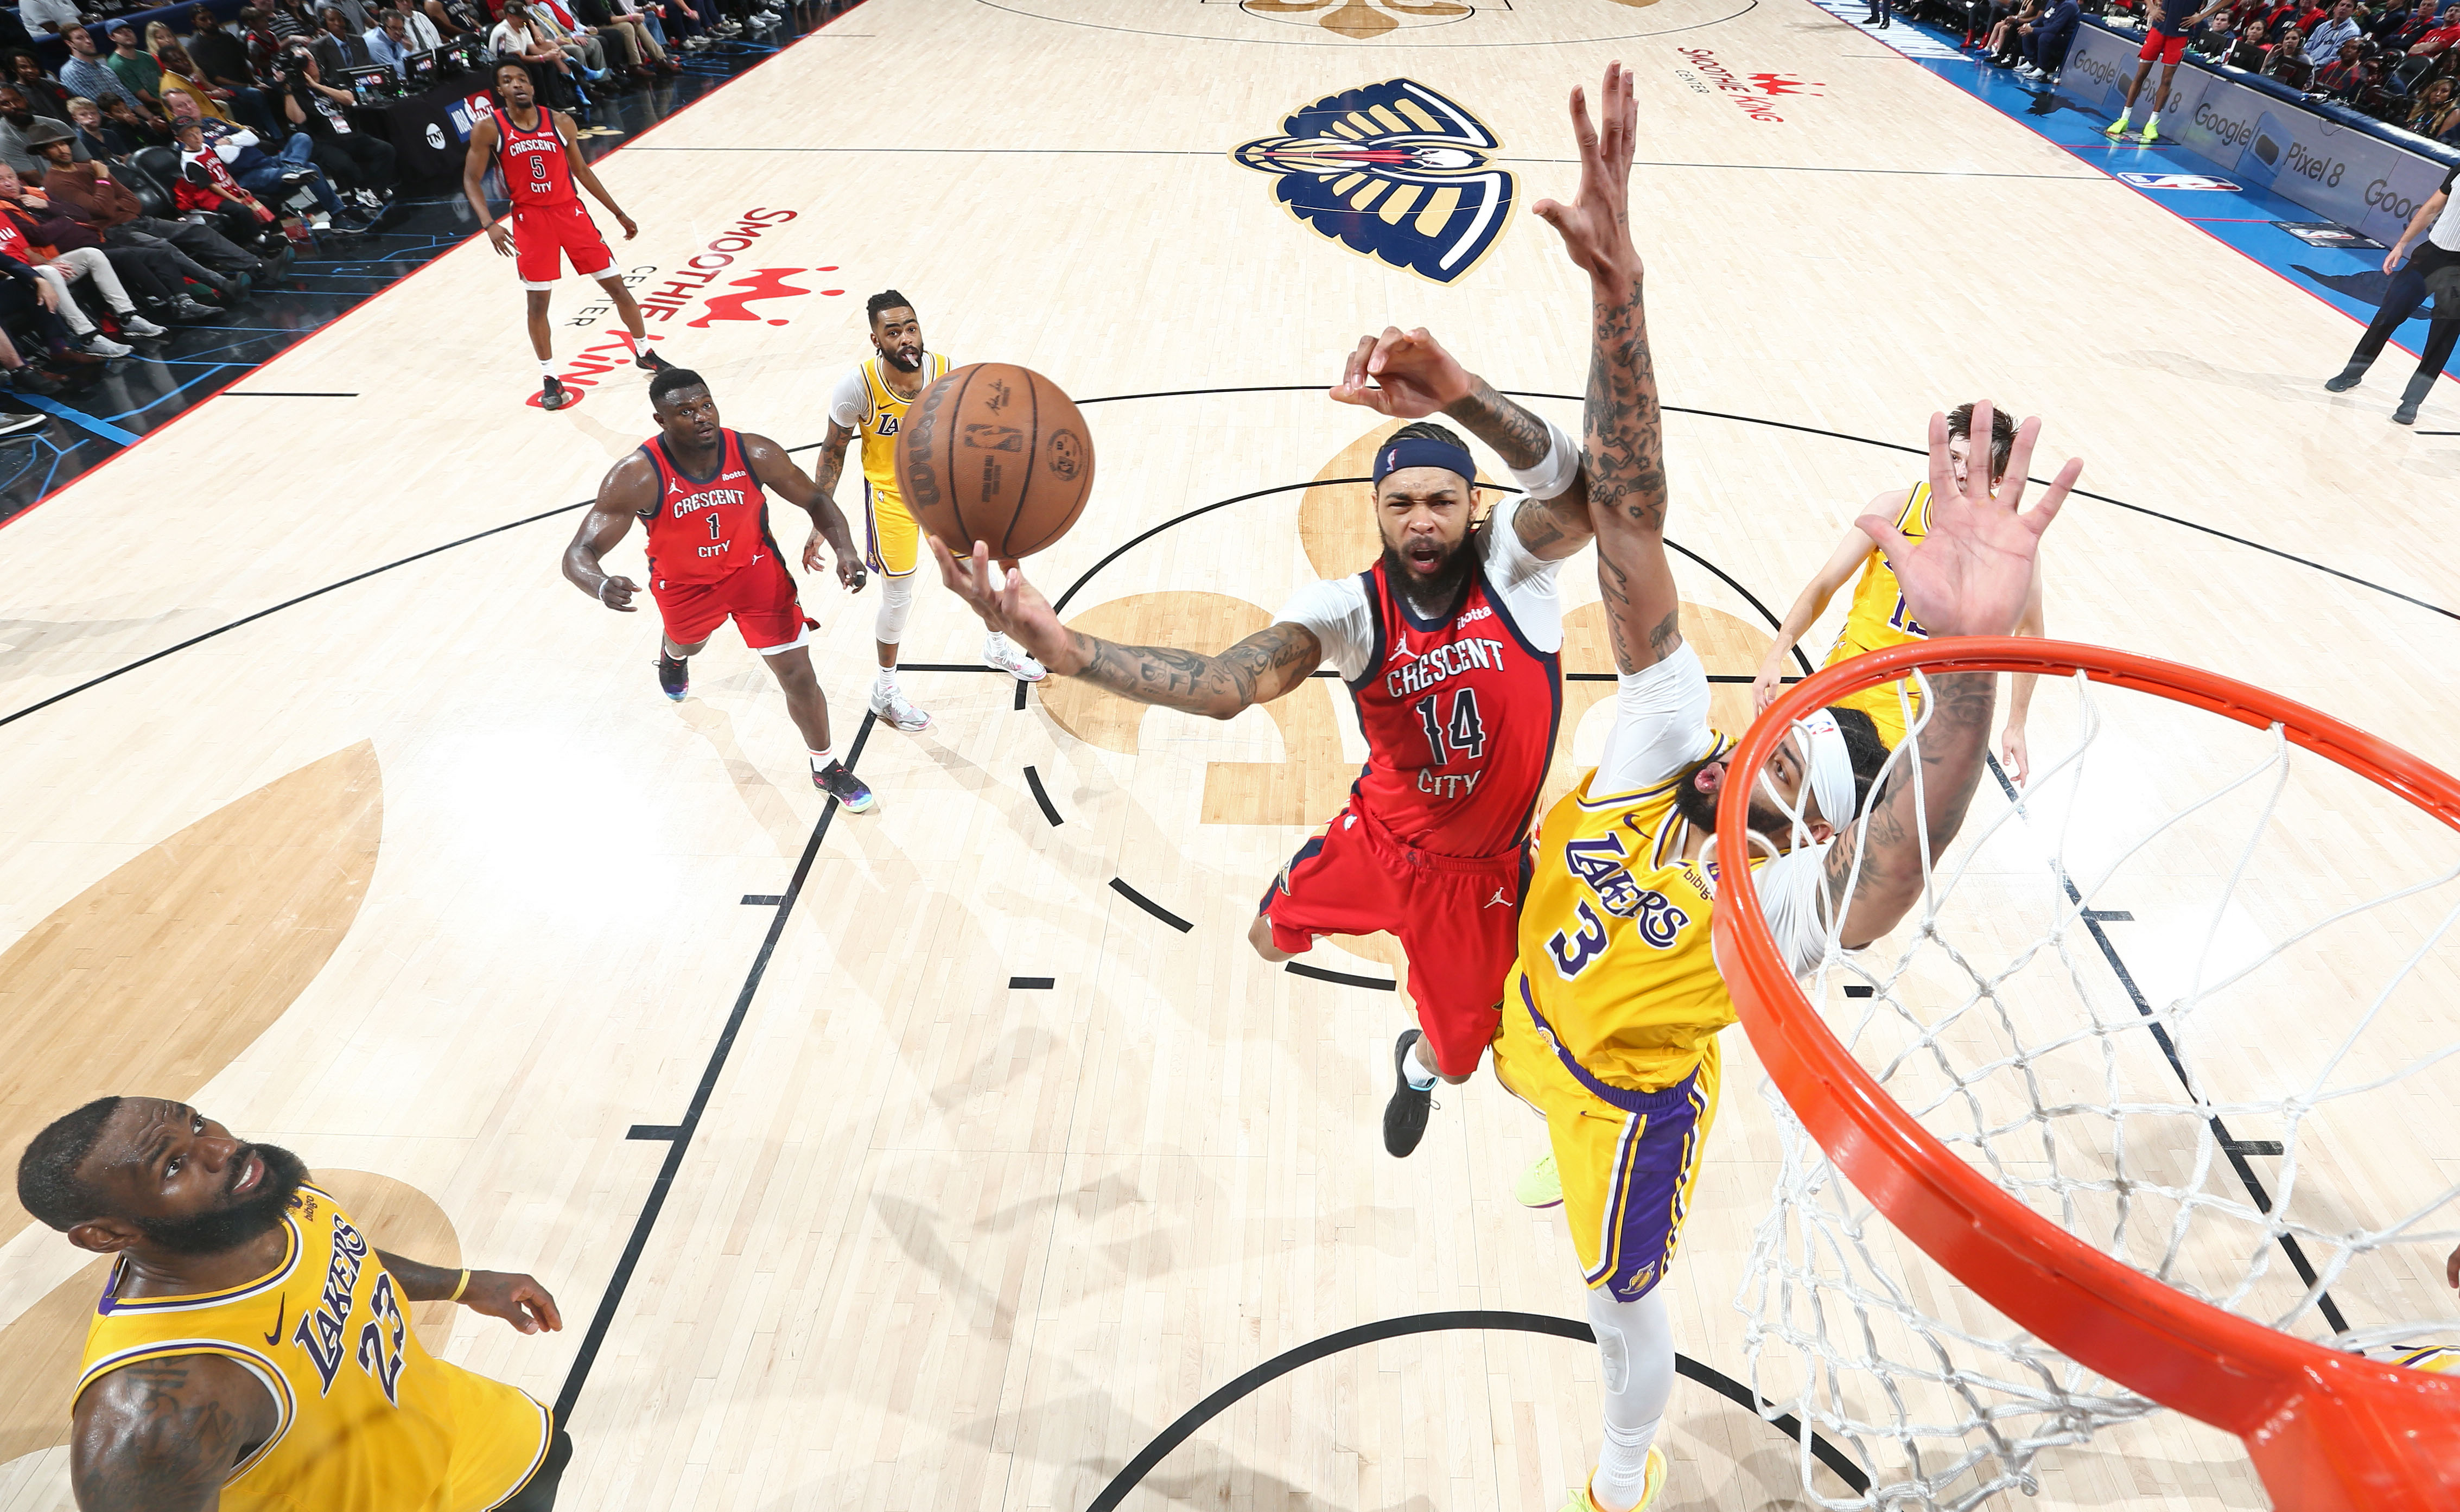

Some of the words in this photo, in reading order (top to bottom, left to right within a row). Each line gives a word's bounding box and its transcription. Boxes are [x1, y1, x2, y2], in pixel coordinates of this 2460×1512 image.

[1675, 69, 1710, 94] CENTER
[1677, 47, 1751, 93] SMOOTHIE
[2074, 49, 2115, 85] Google
[2138, 78, 2173, 110] Pix
[2169, 92, 2182, 114] 8
[509, 139, 557, 157] CRESCENT
[530, 155, 546, 180] 5
[2195, 103, 2252, 146] Google
[2284, 142, 2332, 182] Pixel
[2326, 162, 2345, 188] 8
[2364, 179, 2429, 231] Goo
[530, 181, 552, 193] CITY
[638, 207, 798, 322] SMOOTHIE
[564, 265, 657, 327] CEER
[721, 470, 747, 482] ibotta
[673, 489, 745, 519] CRESCENT
[706, 512, 721, 540] 1
[698, 539, 730, 558] CITY
[1457, 606, 1492, 630] ibotta
[1385, 638, 1504, 698] CRESCENT
[1416, 687, 1486, 765] 14
[1417, 767, 1482, 799] CITY
[1565, 830, 1691, 950] LAKERS
[1543, 897, 1610, 982] 3
[303, 1195, 318, 1222] bibigo
[292, 1212, 369, 1400] LAKERS
[356, 1270, 407, 1409] 23
